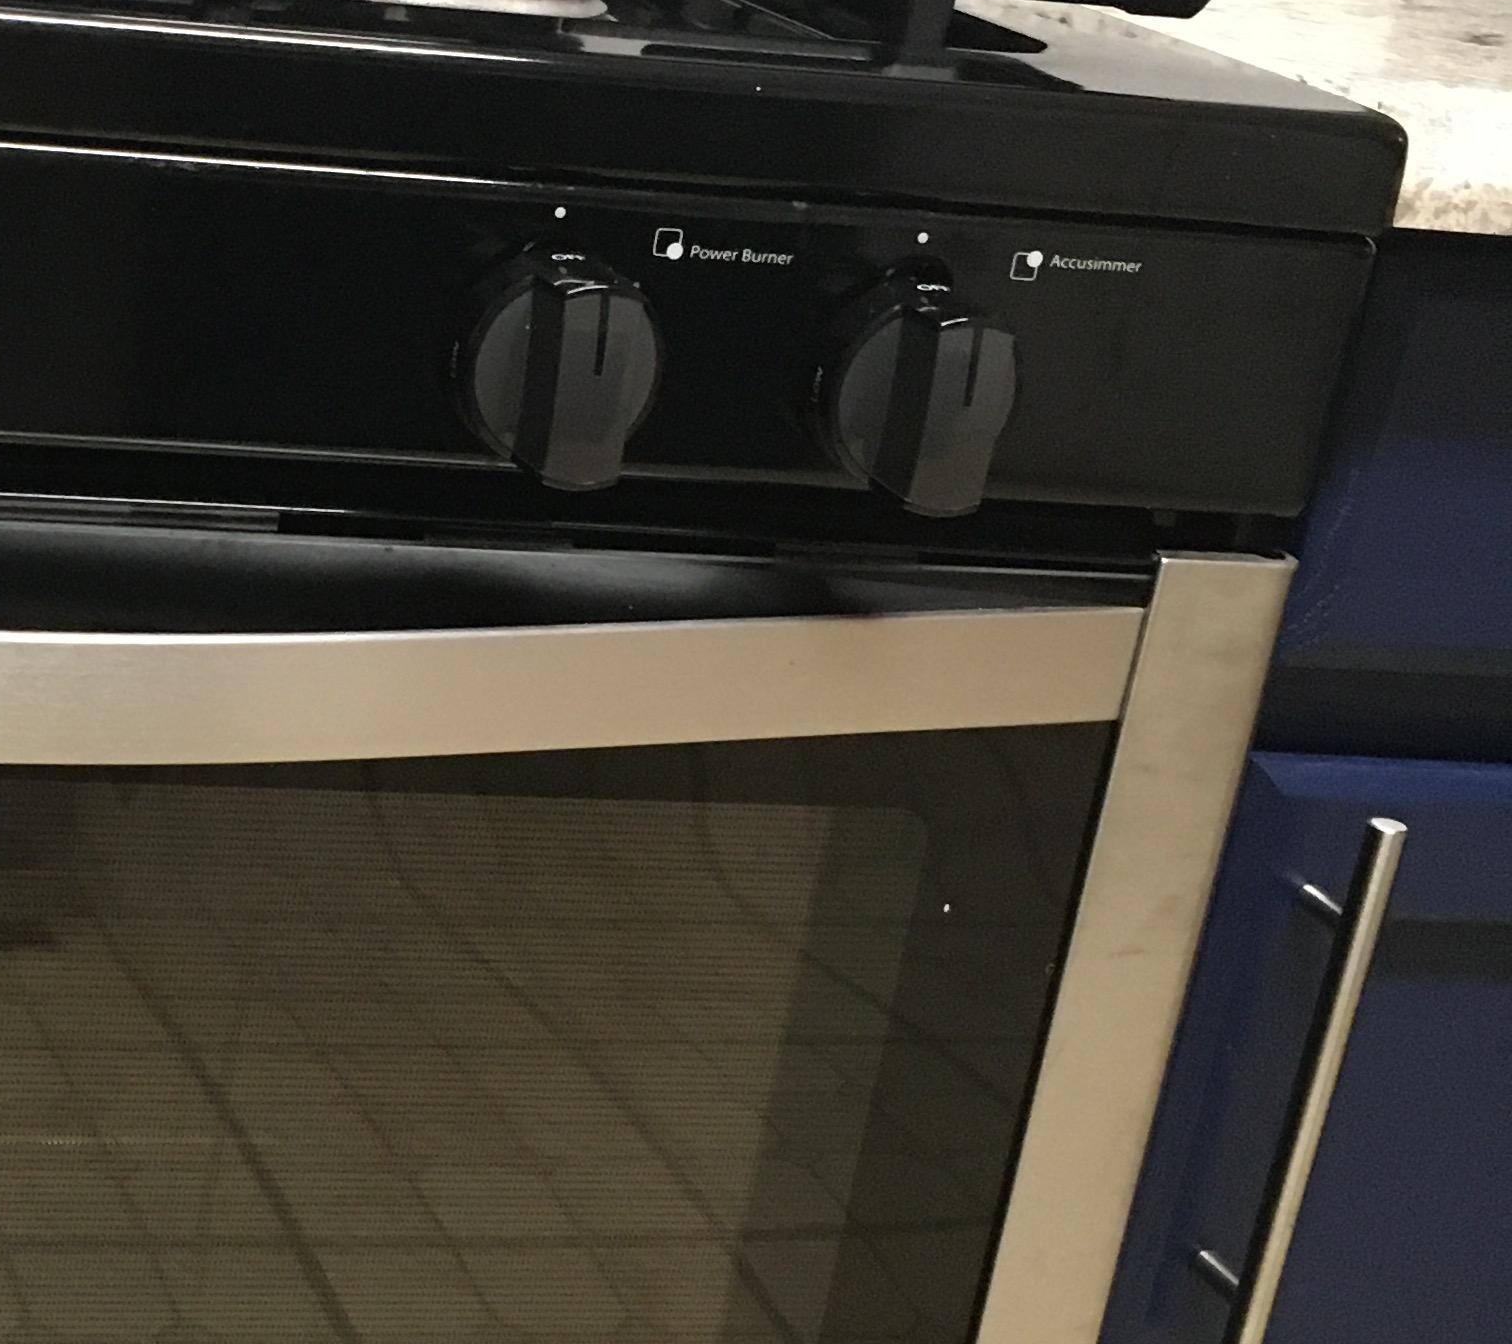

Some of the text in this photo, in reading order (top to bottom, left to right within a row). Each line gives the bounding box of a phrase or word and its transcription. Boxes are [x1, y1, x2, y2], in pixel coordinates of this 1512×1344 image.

[689, 244, 795, 265] Power Burner
[1049, 253, 1144, 274] Accusimmer
